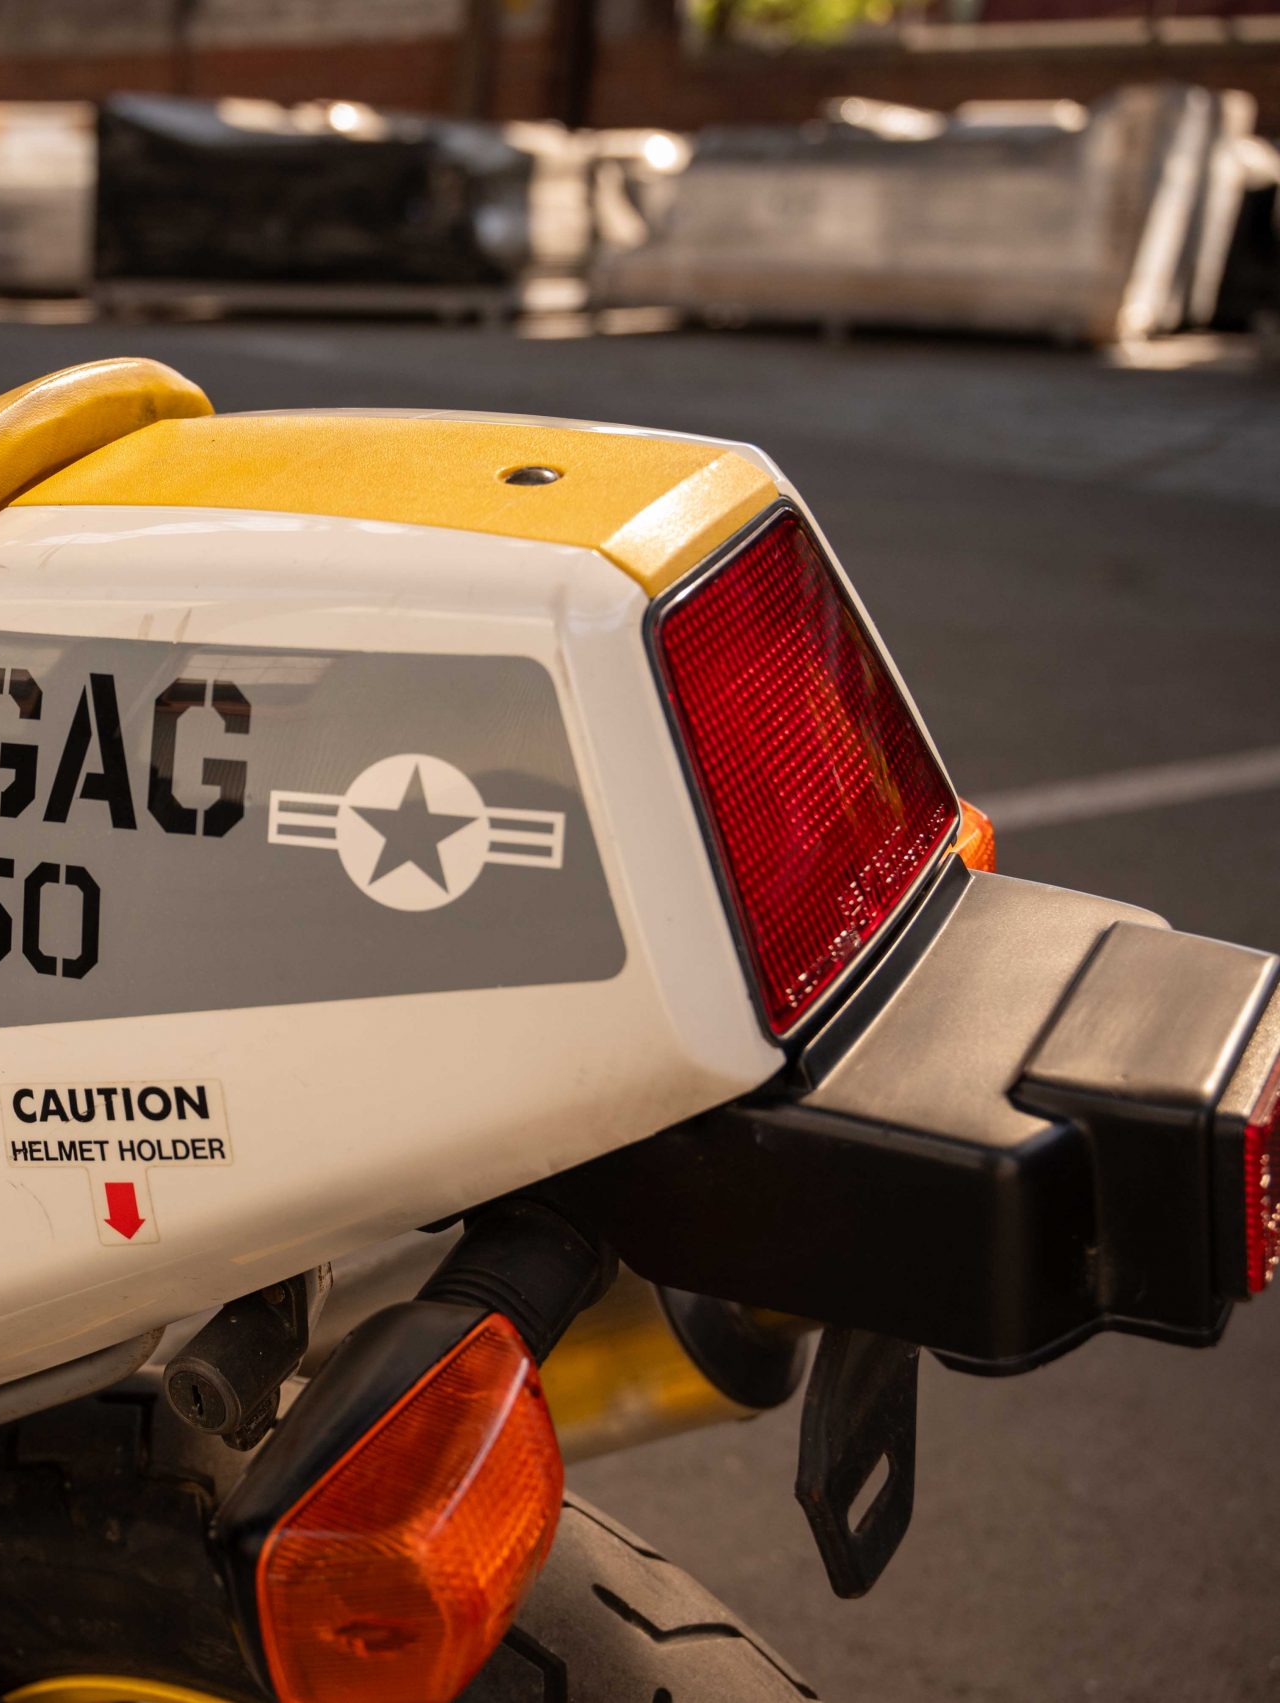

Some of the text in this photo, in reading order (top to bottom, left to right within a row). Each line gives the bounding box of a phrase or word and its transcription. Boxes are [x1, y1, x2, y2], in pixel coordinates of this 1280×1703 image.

[12, 1085, 210, 1123] CAUTION
[11, 1138, 226, 1162] HELMET HOLDER
